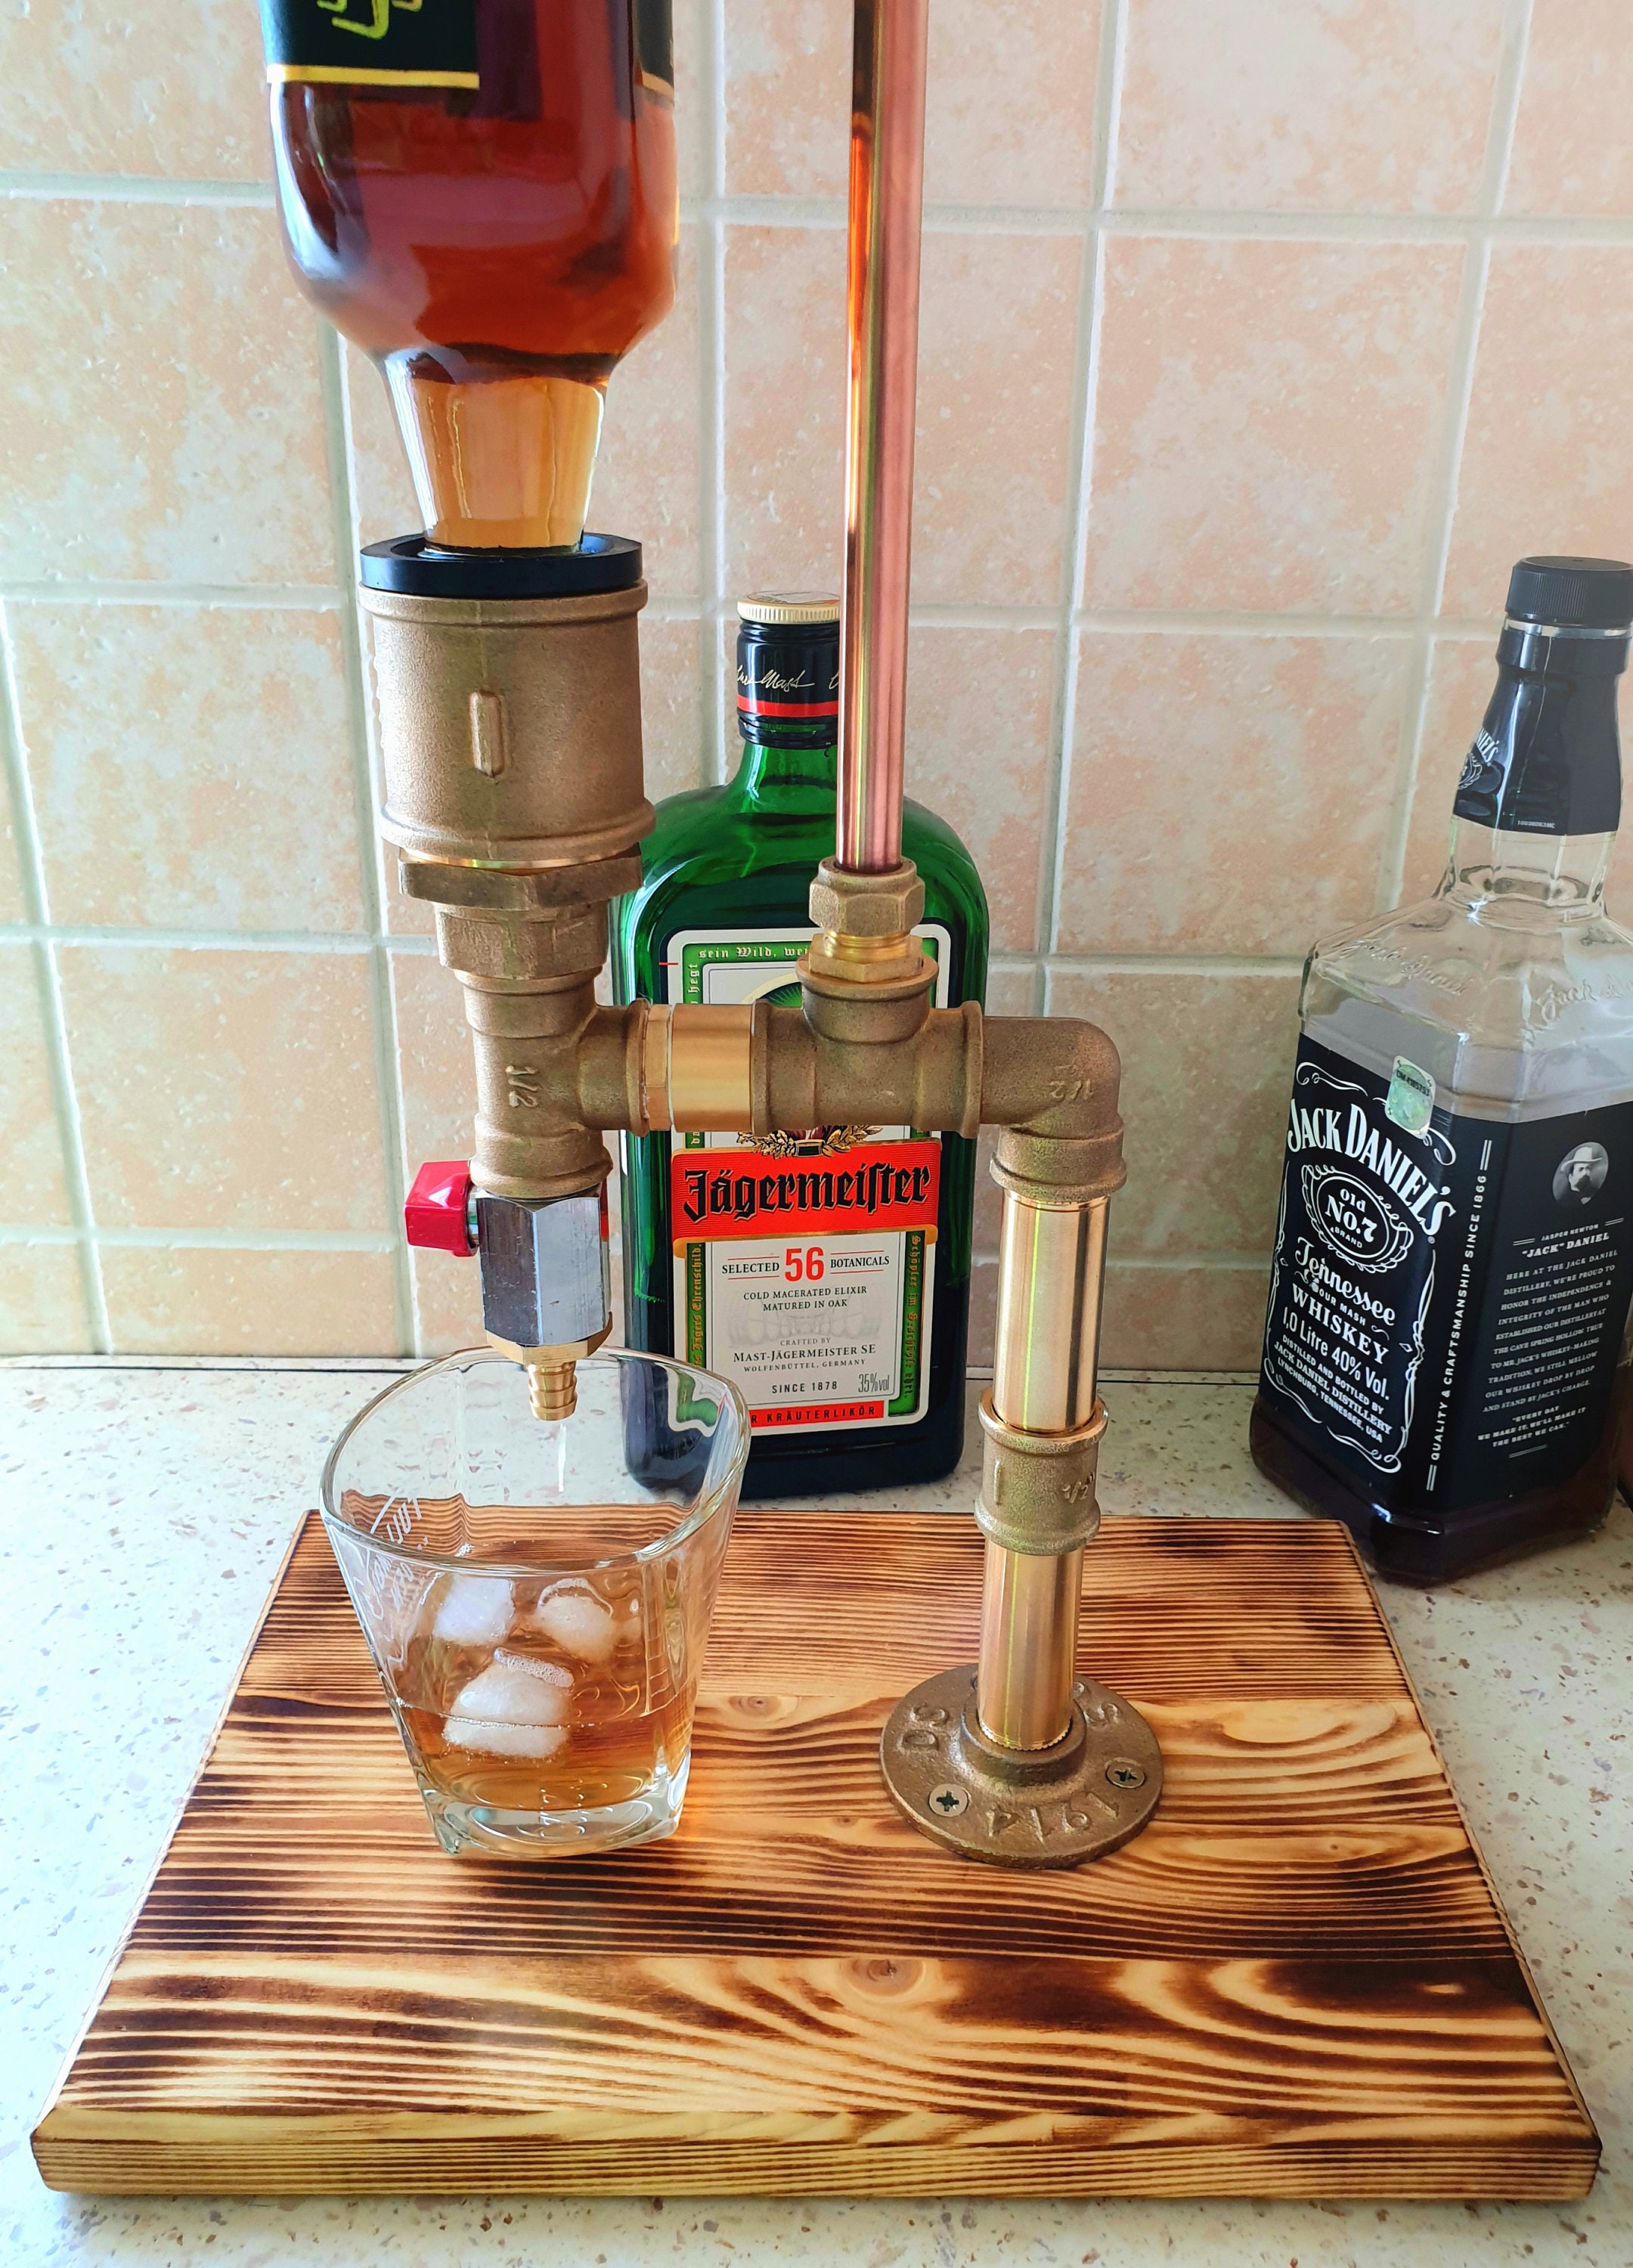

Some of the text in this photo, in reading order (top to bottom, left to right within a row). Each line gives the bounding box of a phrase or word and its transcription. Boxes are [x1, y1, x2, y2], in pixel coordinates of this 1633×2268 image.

[699, 947, 729, 959] sein
[688, 963, 700, 993] hegt
[1287, 1098, 1457, 1236] JACK DANIEL'S
[1340, 1188, 1366, 1213] Old
[1334, 1226, 1362, 1248] BRAND
[1541, 1224, 1599, 1241] JASPER NEWTON
[1566, 1232, 1610, 1249] DANIEL
[722, 1247, 890, 1282] SELECTED 56 BOTANICALS
[1506, 1270, 1530, 1281] HERE
[1547, 1263, 1564, 1272] THE
[1565, 1258, 1586, 1269] JACK
[1589, 1250, 1618, 1262] DANIEL
[1553, 1275, 1577, 1284] WE'RE
[1579, 1268, 1604, 1279] PROUD
[744, 1286, 867, 1300] COLD MACERATED ELIXIR
[1295, 1237, 1396, 1326] Tennessee
[763, 1301, 811, 1312] MATURED
[828, 1299, 847, 1307] OAK
[1501, 1300, 1529, 1310] HONOR
[1531, 1296, 1547, 1305] THE
[1548, 1281, 1604, 1300] INDEPENDENCE
[1340, 1303, 1366, 1326] MASH
[1431, 1176, 1487, 1461] QUALITY & CRAFTSMANSHIP SINCE 1866
[1498, 1294, 1610, 1325] INTEGRITY OF THE MAN WHO
[1292, 1283, 1389, 1365] WHISKEY
[1495, 1325, 1543, 1340] ESTABLISHED
[1544, 1321, 1559, 1331] OUR
[780, 1338, 818, 1346] CRAFTED
[861, 1343, 876, 1354] SE
[1493, 1346, 1509, 1355] THE
[1510, 1342, 1529, 1352] CAVE
[1530, 1336, 1554, 1346] SPRING
[1586, 1323, 1604, 1332] TRUE
[822, 1359, 866, 1367] GERMANY
[1300, 1320, 1328, 1356] Litre
[1331, 1346, 1362, 1381] 40%
[1365, 1366, 1390, 1400] Vol.
[1534, 1365, 1545, 1374] WE
[1546, 1361, 1566, 1371] STILL
[1568, 1351, 1597, 1365] MELLOW
[1282, 1334, 1385, 1414] DISTILLED AND BOTTLED BY
[1485, 1390, 1504, 1399] OUR
[1505, 1379, 1542, 1394] WHISKEY
[1542, 1374, 1563, 1386] DROP
[1576, 1365, 1596, 1376] DROP
[772, 1383, 806, 1394] SINCE
[811, 1380, 838, 1391] 1878
[1274, 1341, 1393, 1435] JACK DANIEL DISTILLERY
[1278, 1357, 1383, 1443] LYNCHBURG, TENNESSEE, USA
[1483, 1404, 1500, 1412] AND
[1501, 1398, 1526, 1408] STAND
[1545, 1405, 1560, 1414] DAY
[767, 1406, 875, 1423] KRÄUTERLIKÖR
[1492, 1427, 1517, 1437] MAKE
[1554, 1410, 1576, 1421] MAKE
[1492, 1439, 1510, 1447] THE
[1511, 1433, 1532, 1442] BEST
[1535, 1428, 1547, 1436] WE
